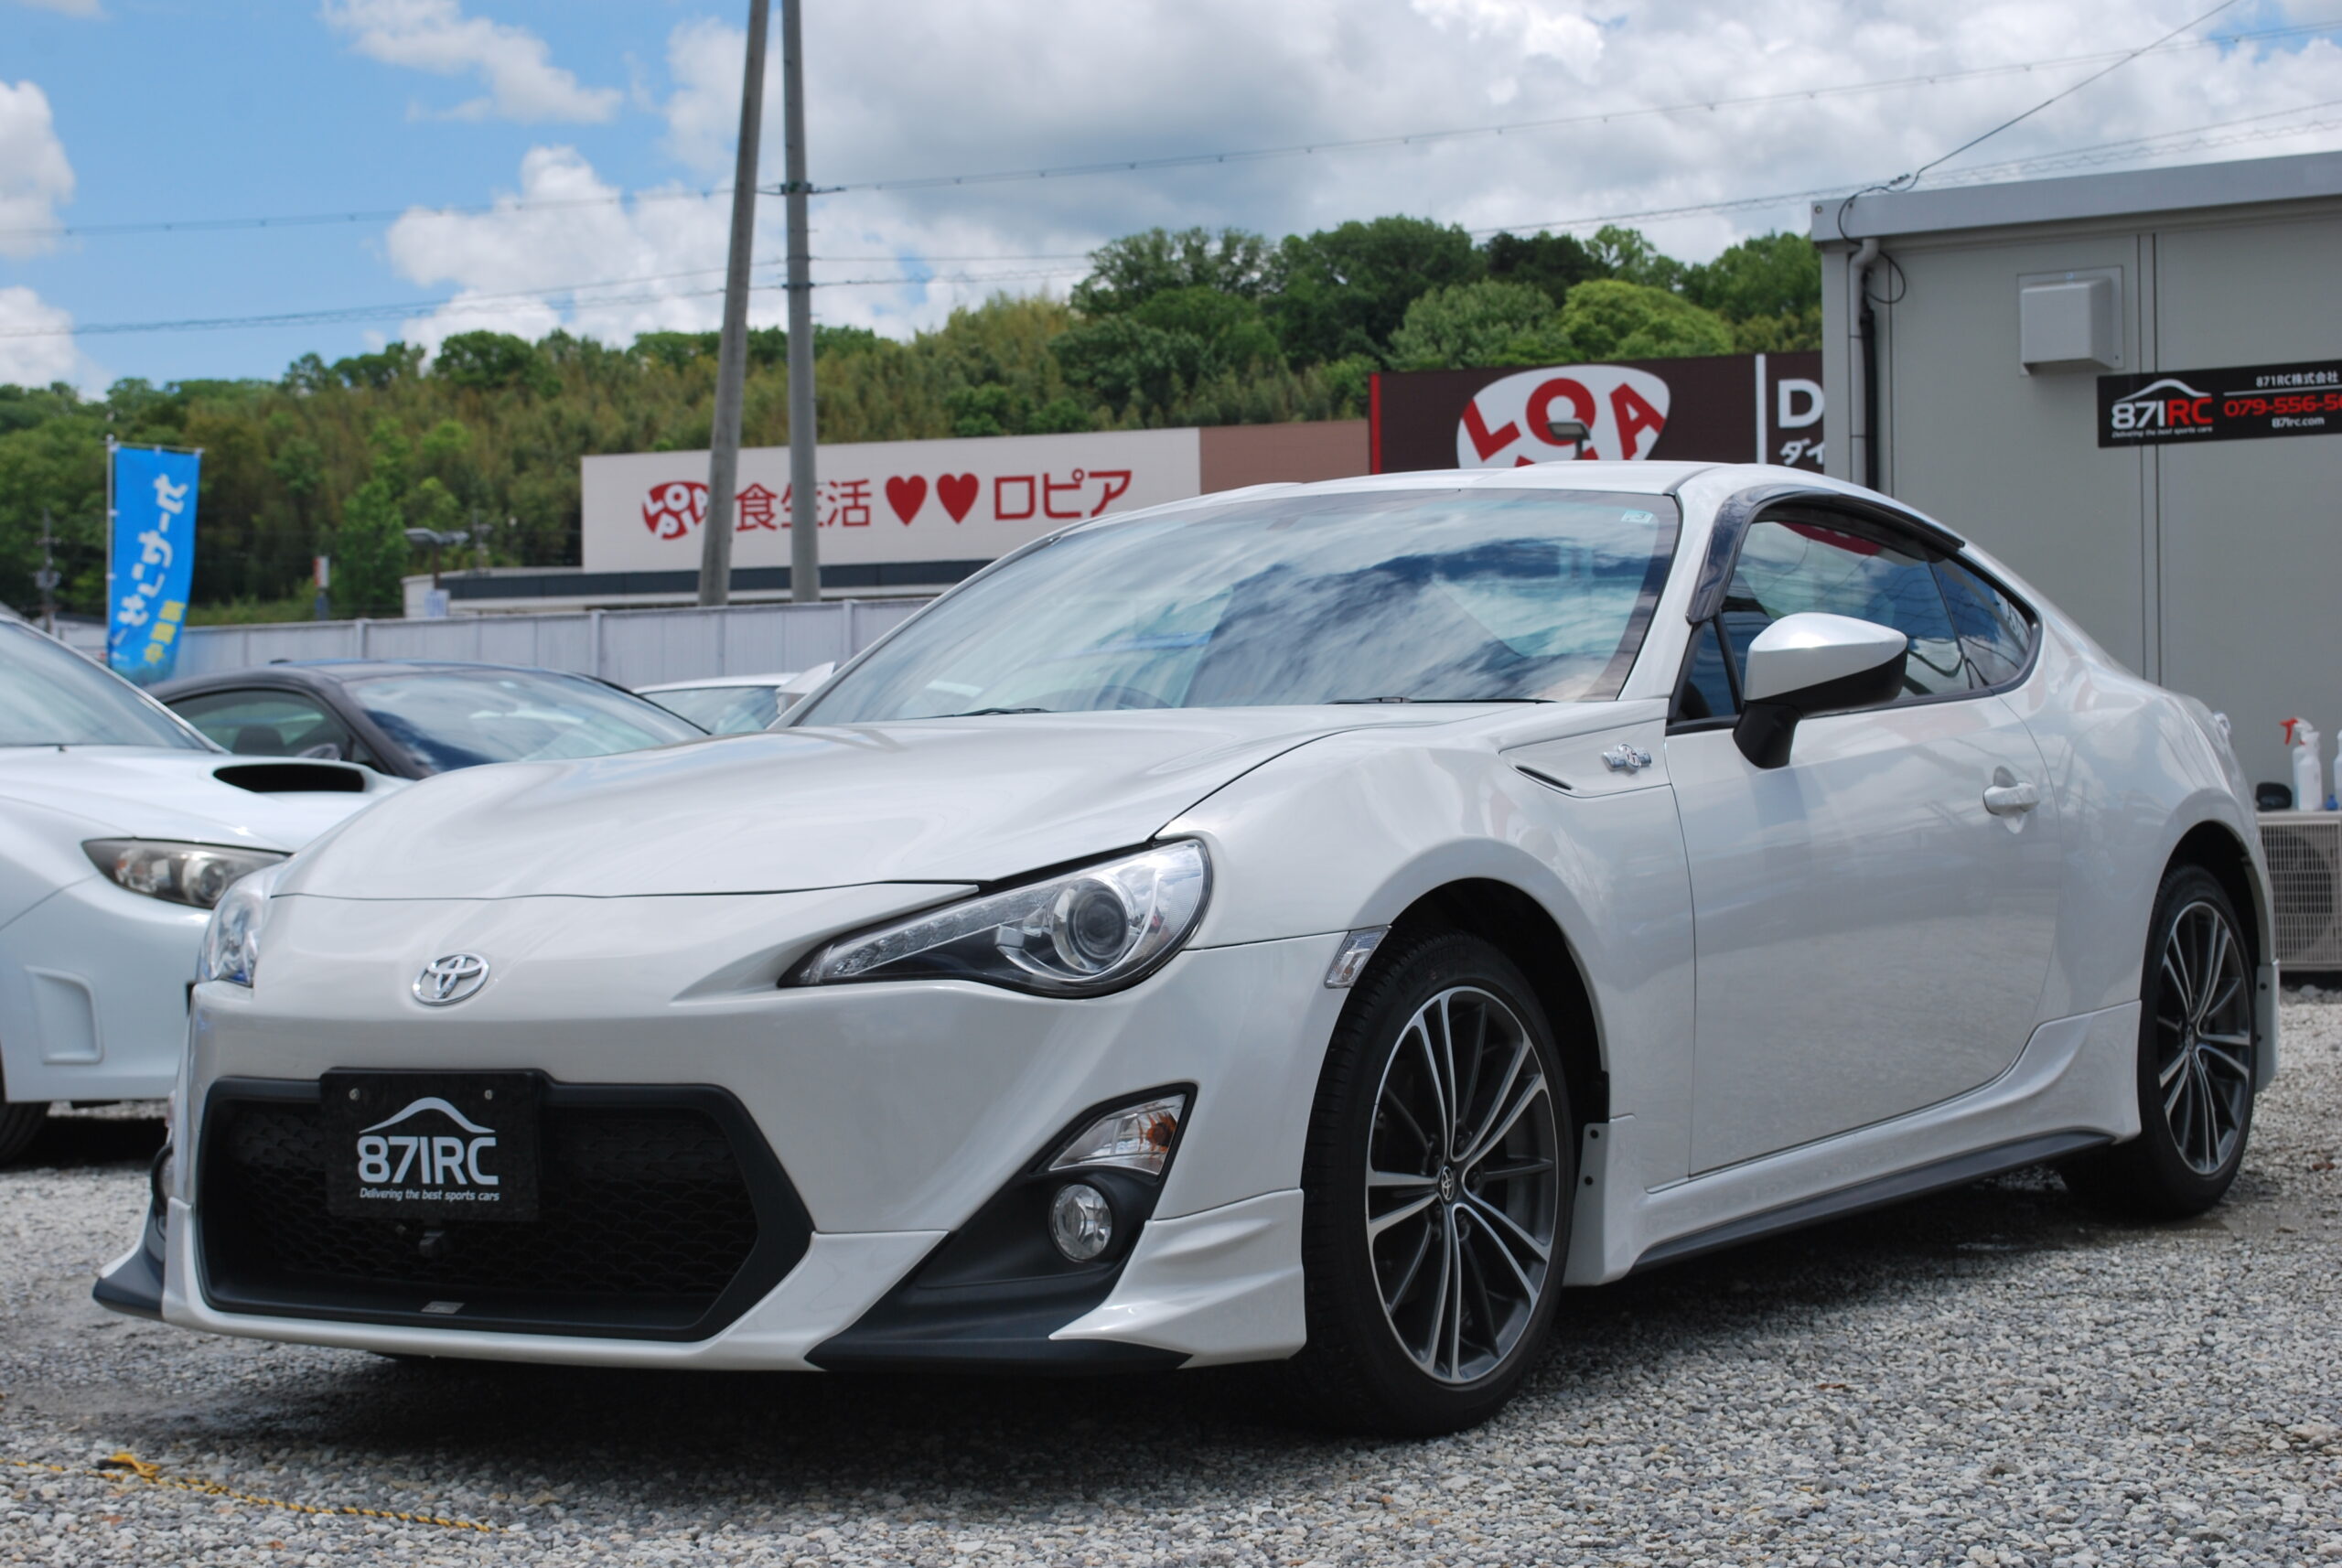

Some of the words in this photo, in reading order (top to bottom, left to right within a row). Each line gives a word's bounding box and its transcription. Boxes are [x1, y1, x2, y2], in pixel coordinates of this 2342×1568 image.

[994, 469, 1133, 521] ロピア
[360, 1187, 403, 1201] Delivering
[405, 1189, 420, 1199] the
[422, 1190, 442, 1200] best
[445, 1191, 476, 1202] sports
[478, 1192, 500, 1201] cars
